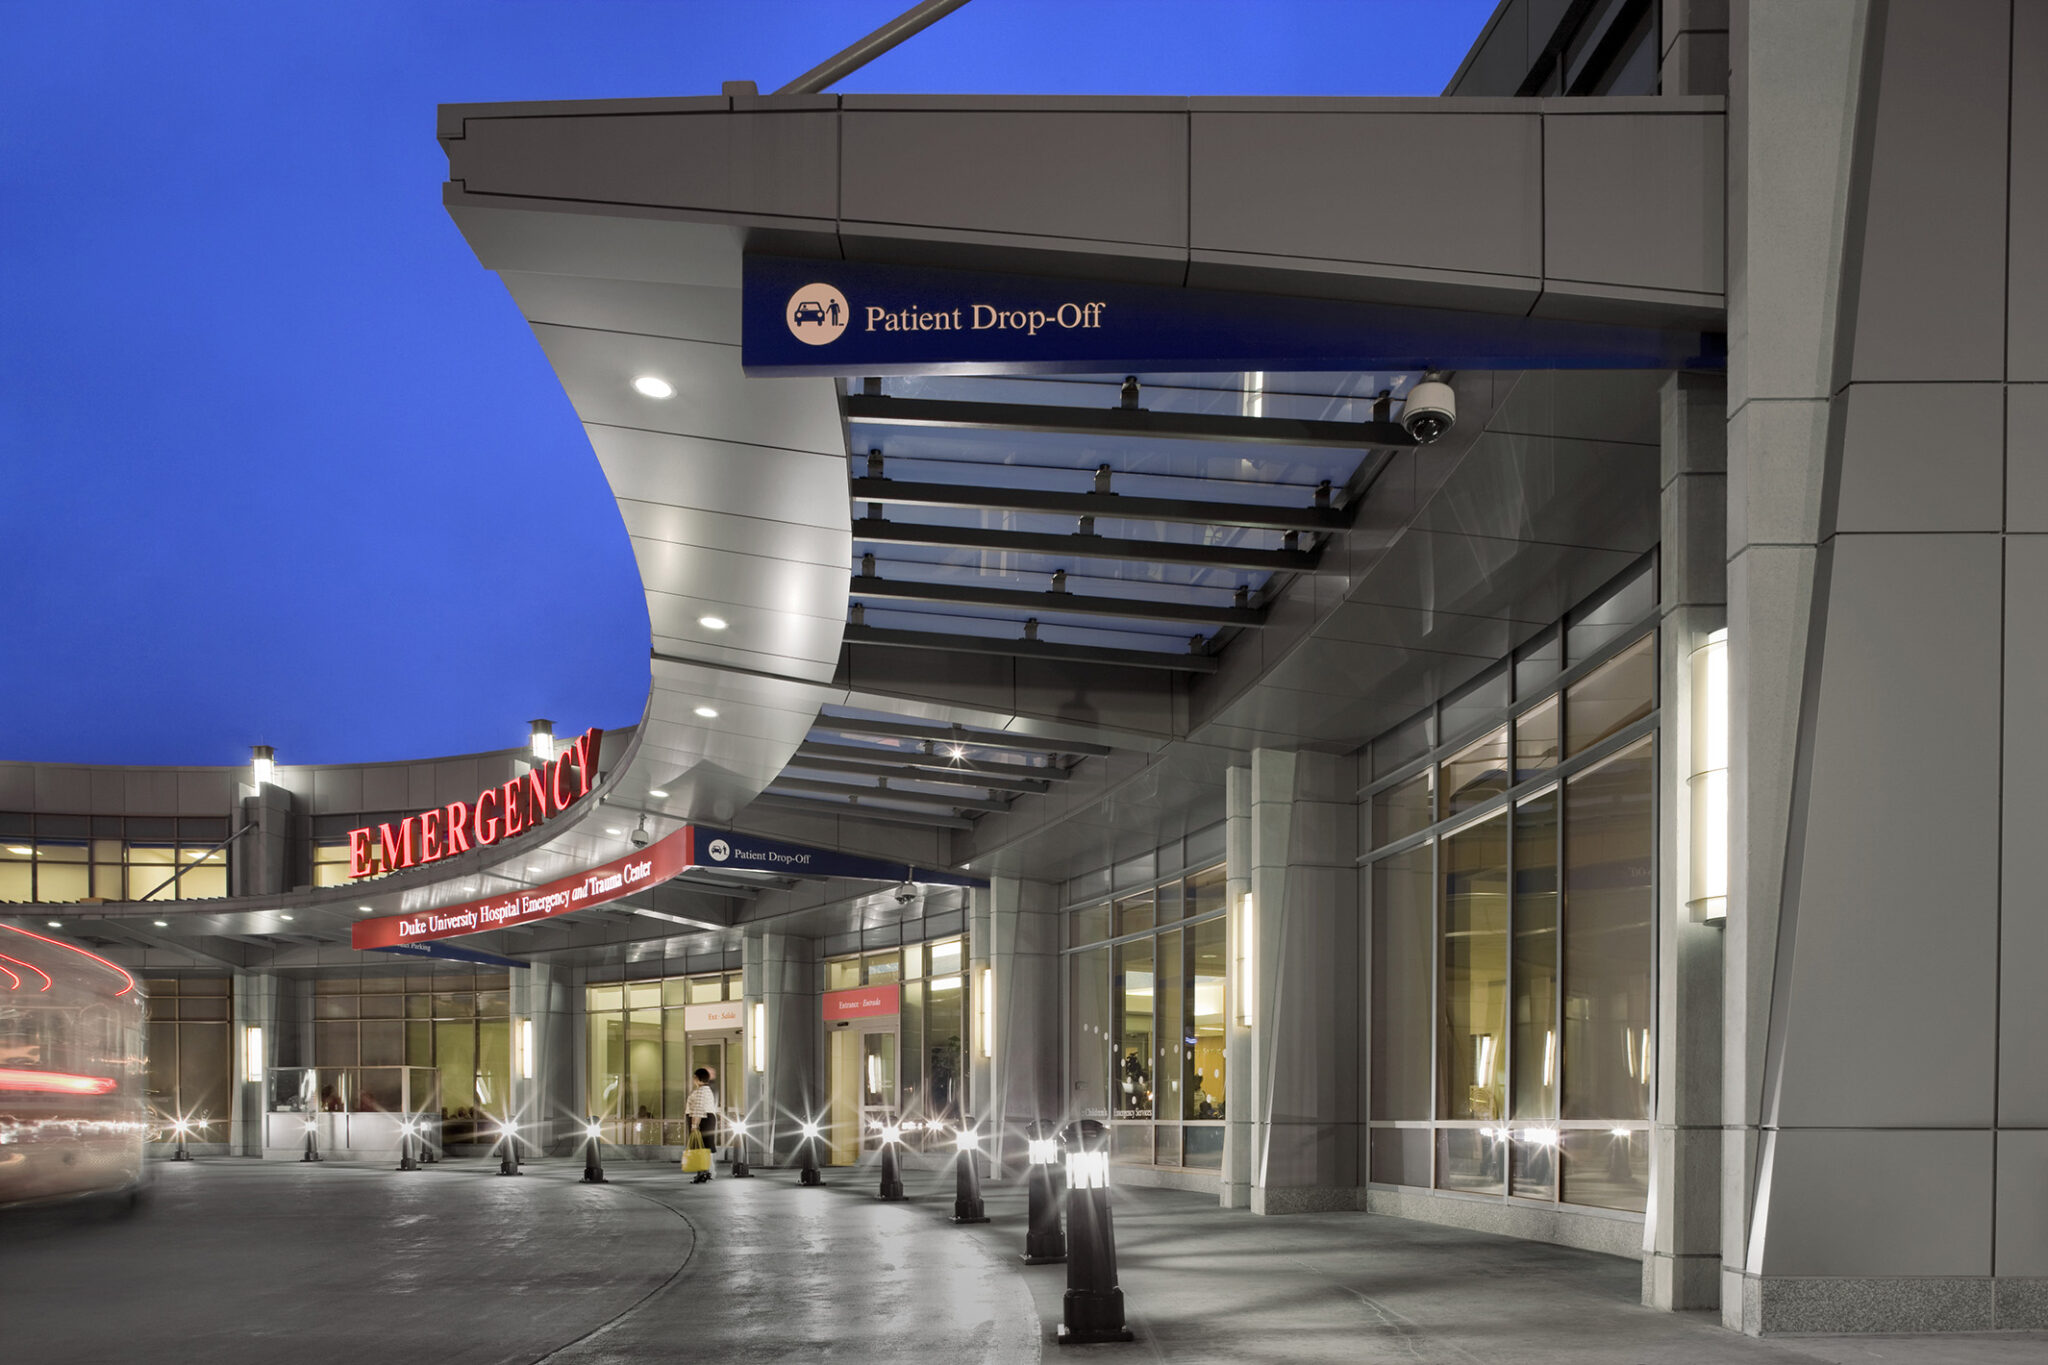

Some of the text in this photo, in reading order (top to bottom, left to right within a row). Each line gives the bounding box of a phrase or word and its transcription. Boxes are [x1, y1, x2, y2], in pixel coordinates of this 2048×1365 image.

[865, 302, 1106, 336] Patient Drop-Off
[347, 727, 603, 879] EMERGENCY
[734, 849, 811, 865] Patient Drop-Off
[399, 861, 652, 937] Duke University Hospital Emergency and Trauma Center
